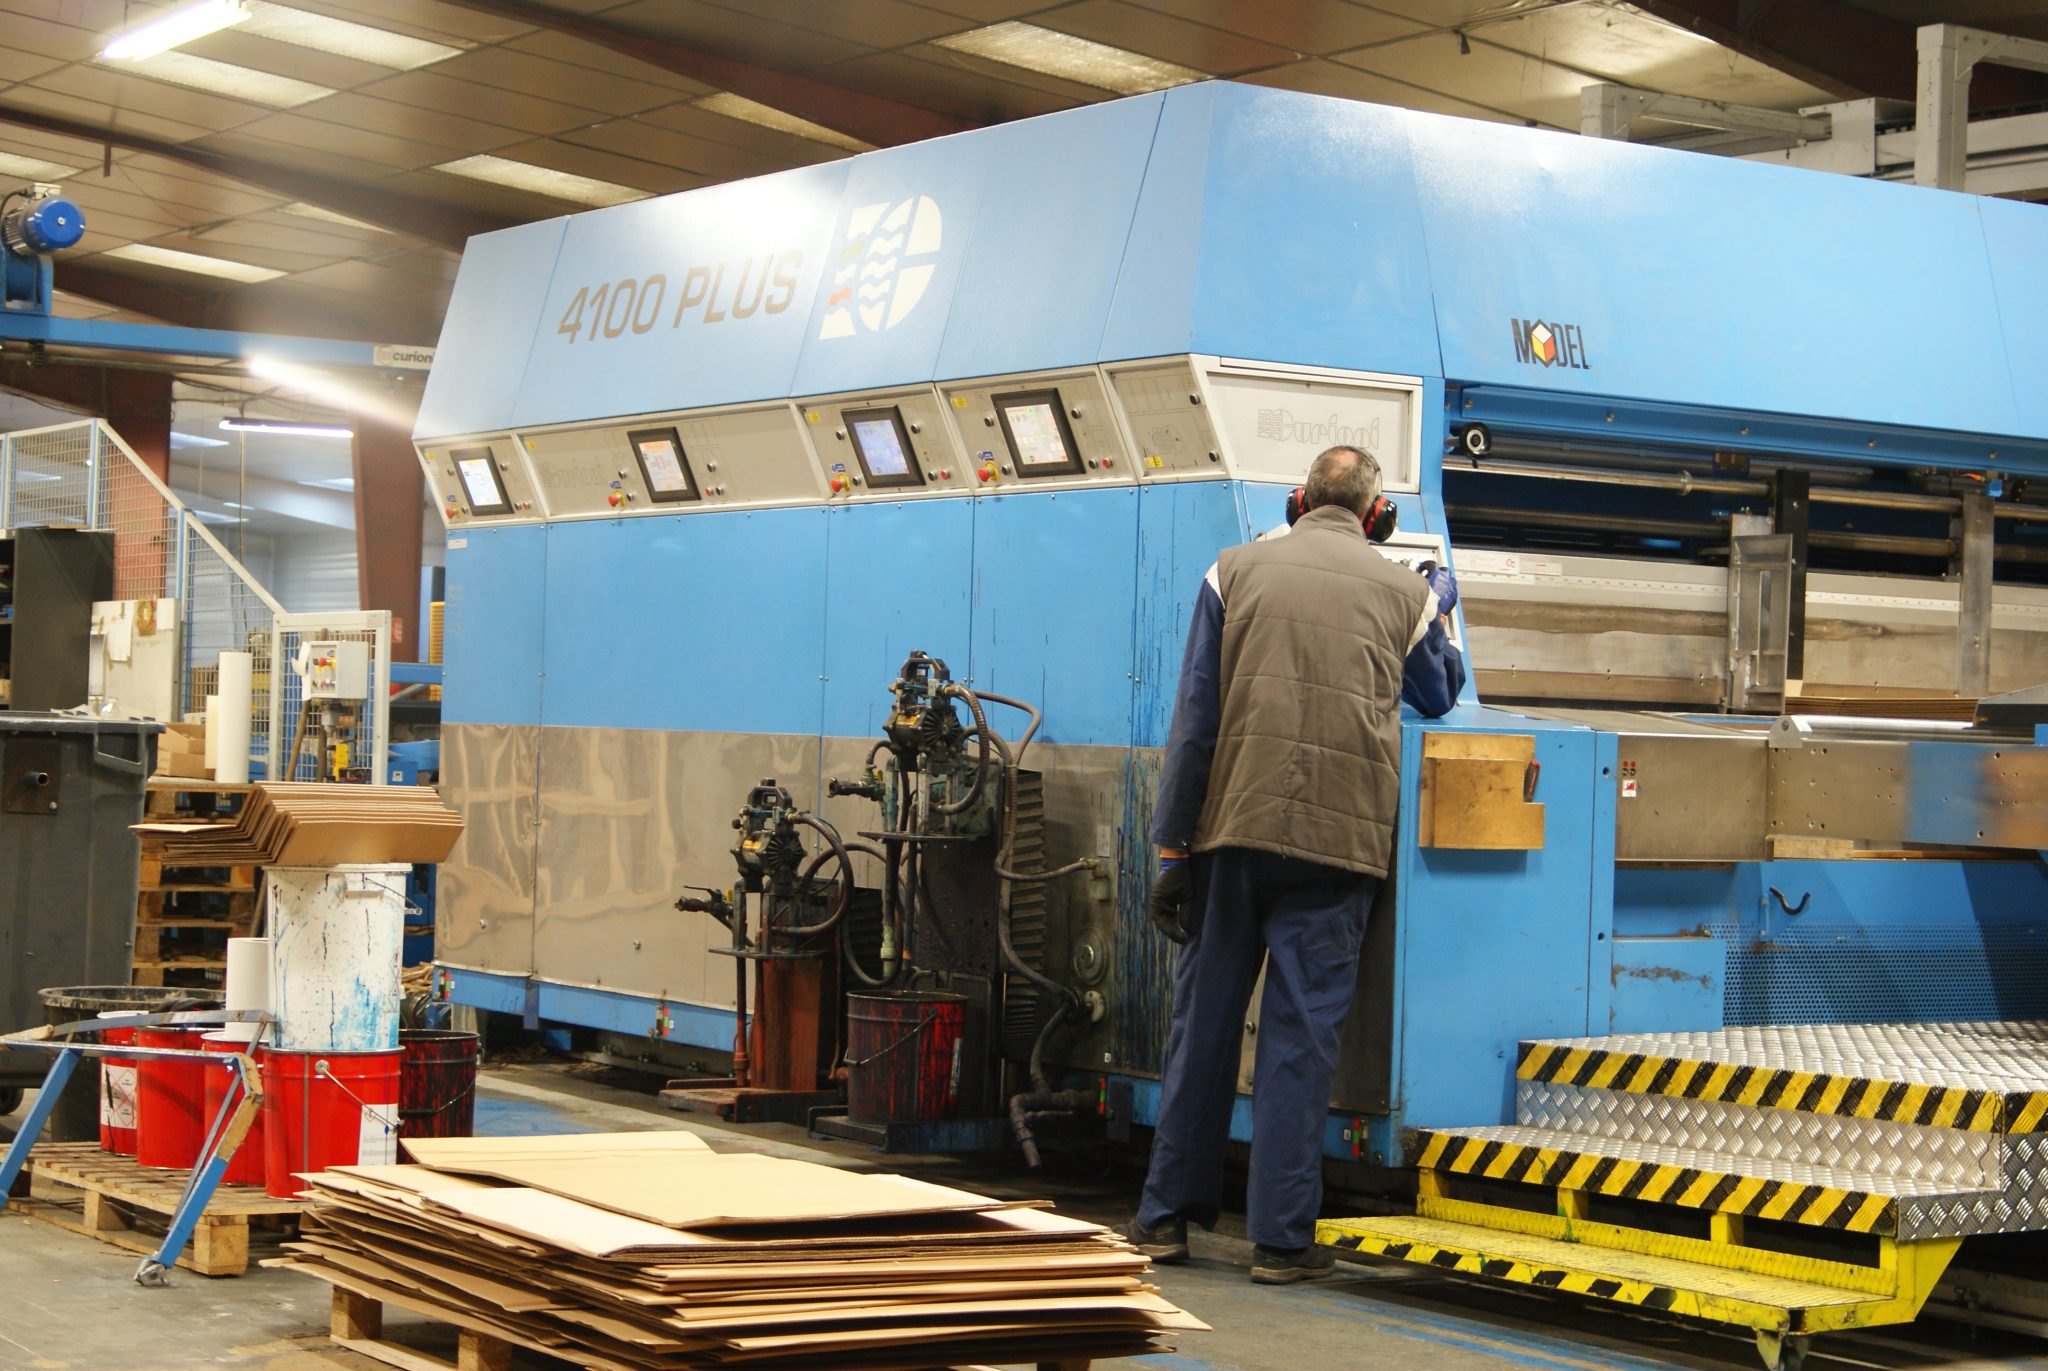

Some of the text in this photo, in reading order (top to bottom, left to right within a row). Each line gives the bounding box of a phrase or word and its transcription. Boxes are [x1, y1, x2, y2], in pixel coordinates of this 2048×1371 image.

[557, 249, 805, 344] 4100 PLUS
[1510, 318, 1590, 369] MODEL
